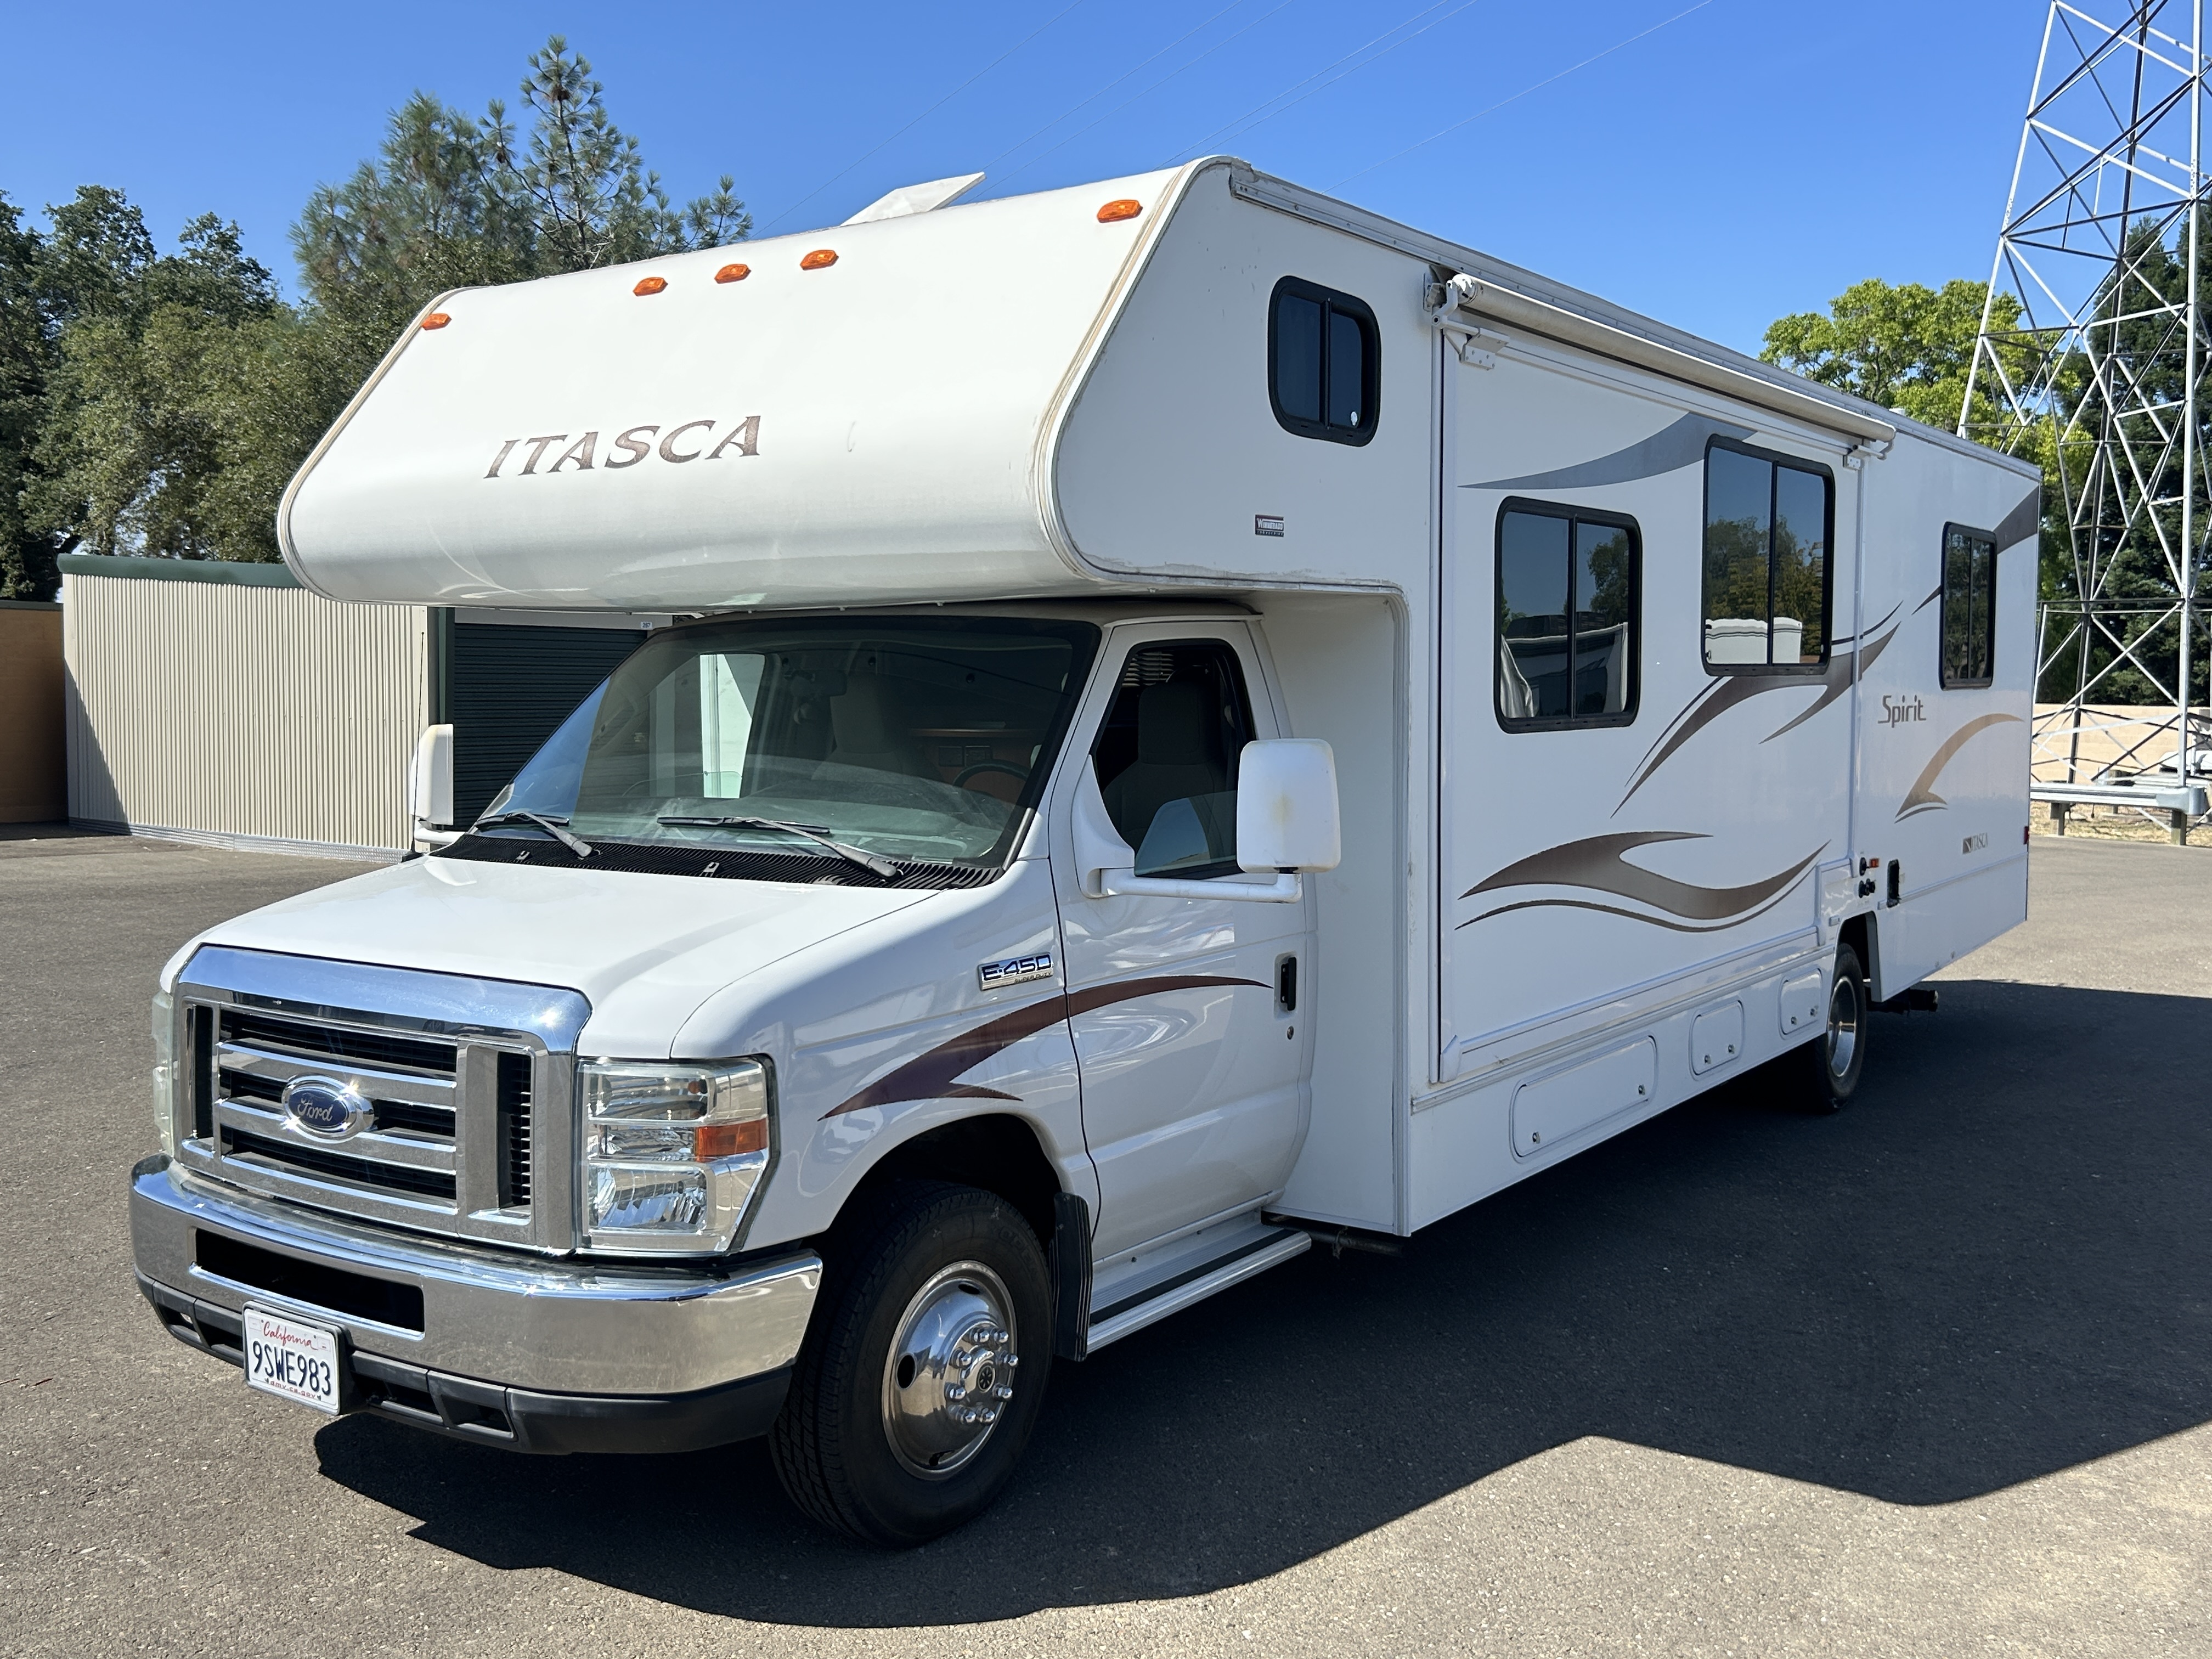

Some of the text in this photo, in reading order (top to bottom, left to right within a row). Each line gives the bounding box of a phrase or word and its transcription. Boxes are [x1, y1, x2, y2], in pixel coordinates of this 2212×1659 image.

[483, 415, 761, 478] ITASCA
[1877, 695, 1926, 728] Spirit
[297, 1097, 334, 1122] Ford
[263, 1321, 318, 1351] California
[253, 1340, 331, 1396] 9SWE983
